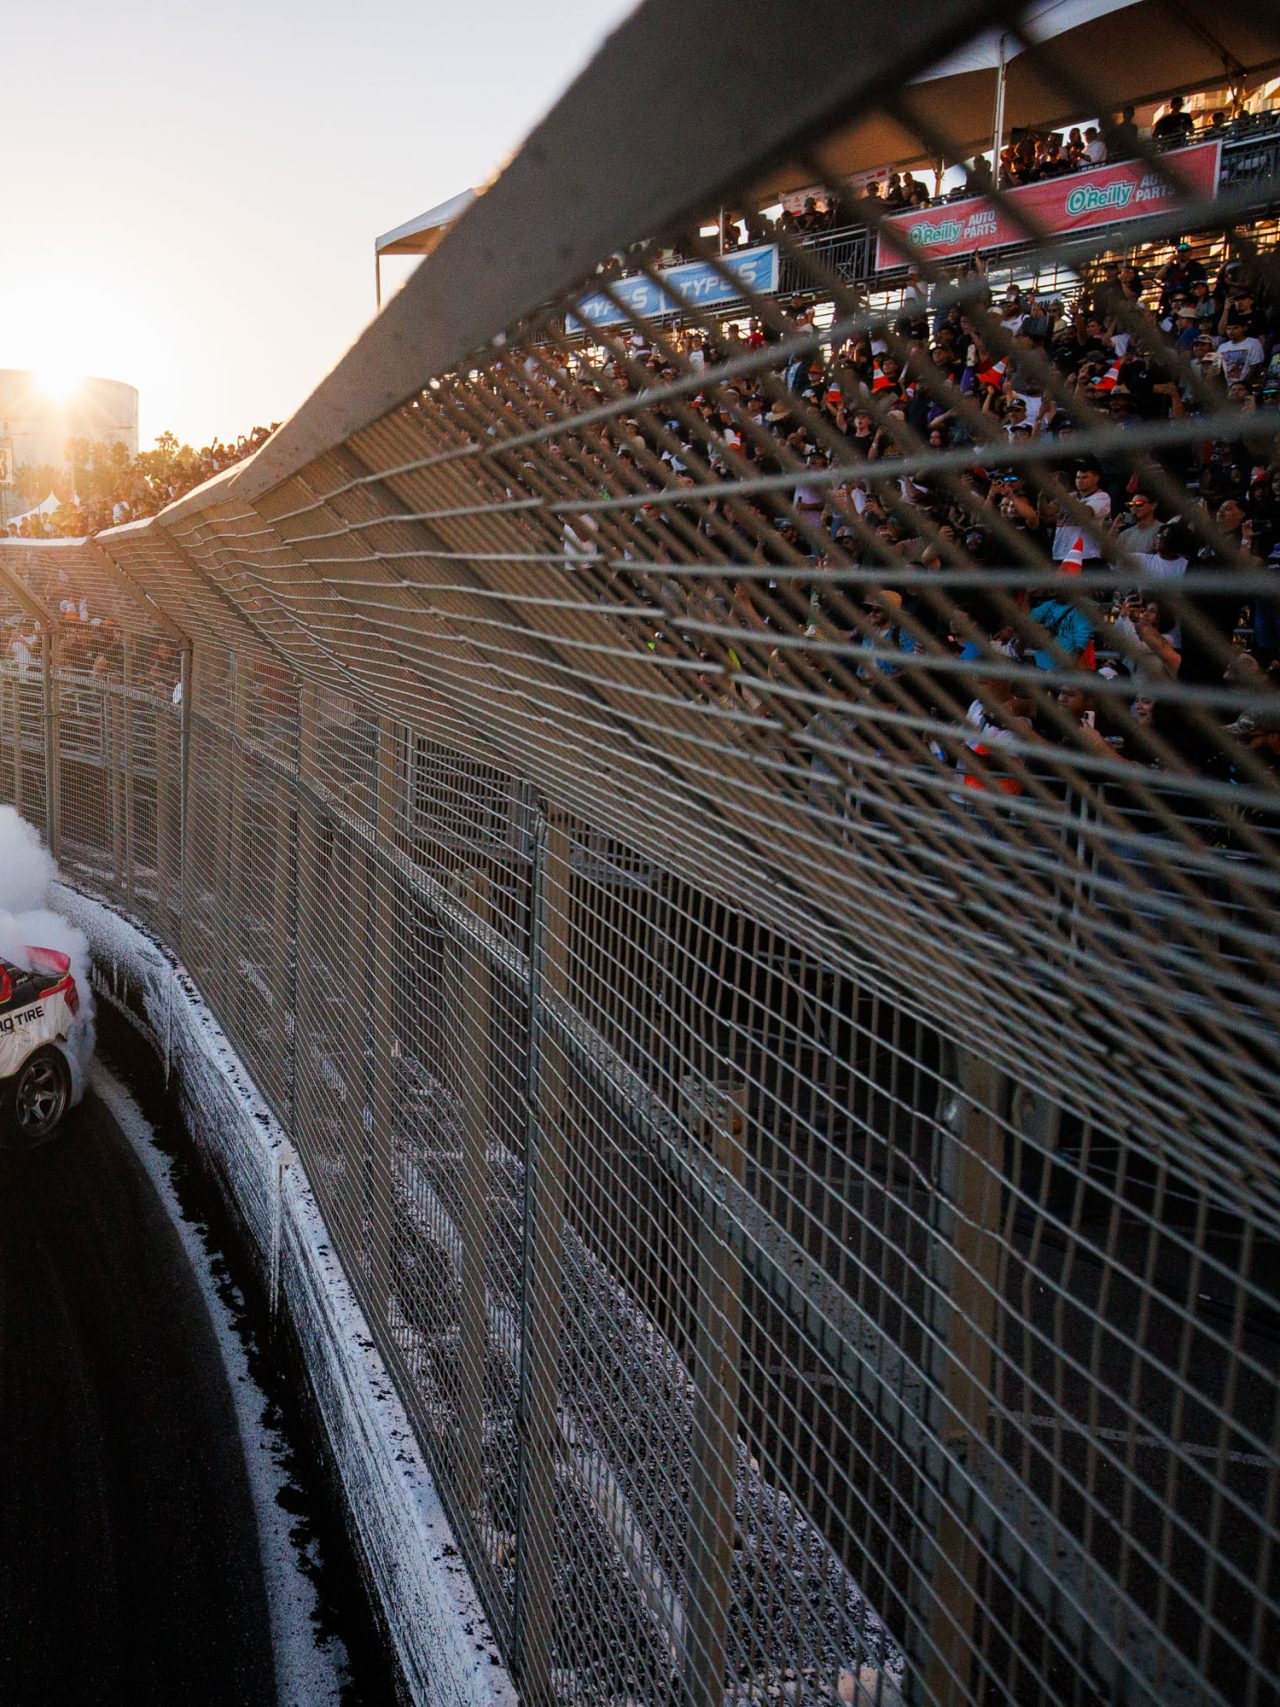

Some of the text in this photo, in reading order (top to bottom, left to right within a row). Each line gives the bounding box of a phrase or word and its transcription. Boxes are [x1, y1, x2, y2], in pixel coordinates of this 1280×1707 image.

[1064, 181, 1136, 217] O'Reilly
[967, 210, 995, 227] AUTO
[908, 219, 965, 248] O'Reilly
[963, 222, 997, 240] PARTS
[15, 1006, 45, 1026] TIRE
